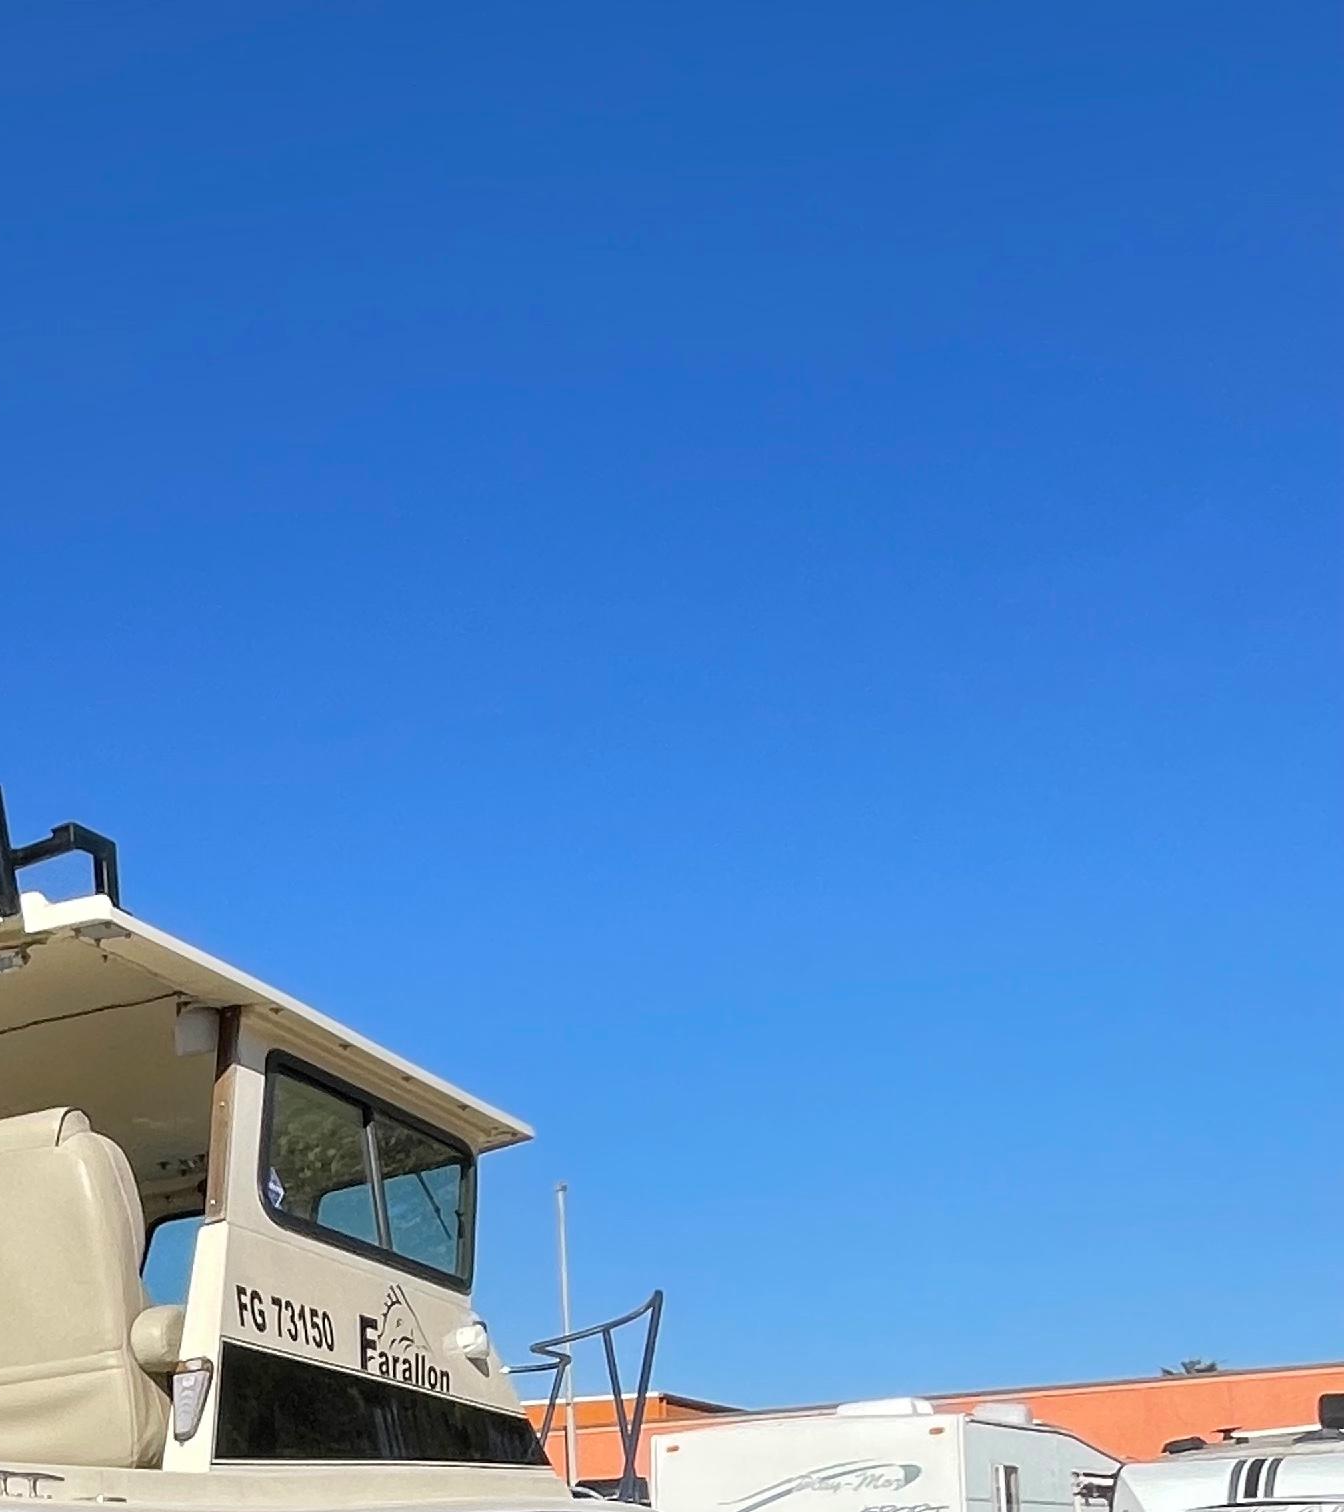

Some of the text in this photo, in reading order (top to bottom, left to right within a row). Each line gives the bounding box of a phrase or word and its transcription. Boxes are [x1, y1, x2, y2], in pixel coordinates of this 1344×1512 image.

[235, 1284, 335, 1352] FG 73150
[359, 1314, 450, 1394] Farallon
